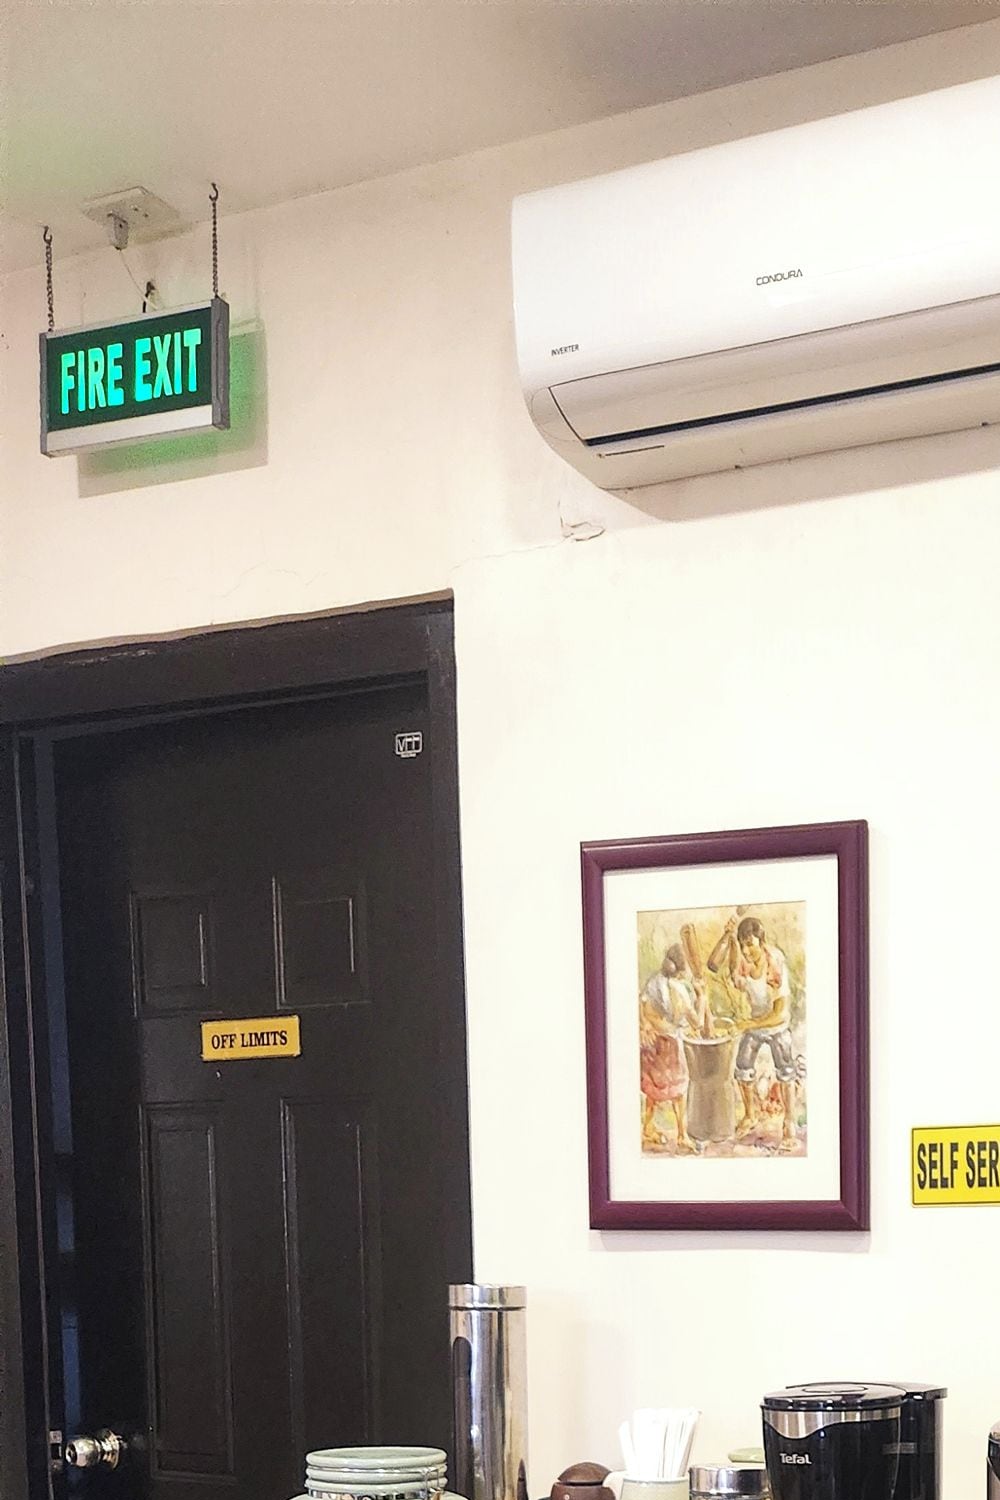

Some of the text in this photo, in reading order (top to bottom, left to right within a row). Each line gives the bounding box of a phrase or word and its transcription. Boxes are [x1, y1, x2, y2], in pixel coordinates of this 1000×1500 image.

[756, 268, 803, 286] CONDURA
[551, 344, 580, 357] INVERTER
[61, 328, 201, 415] FIRE EXIT
[211, 1030, 288, 1049] OFF LIMITS
[917, 1142, 959, 1190] SELF
[779, 1453, 812, 1465] Tefal
